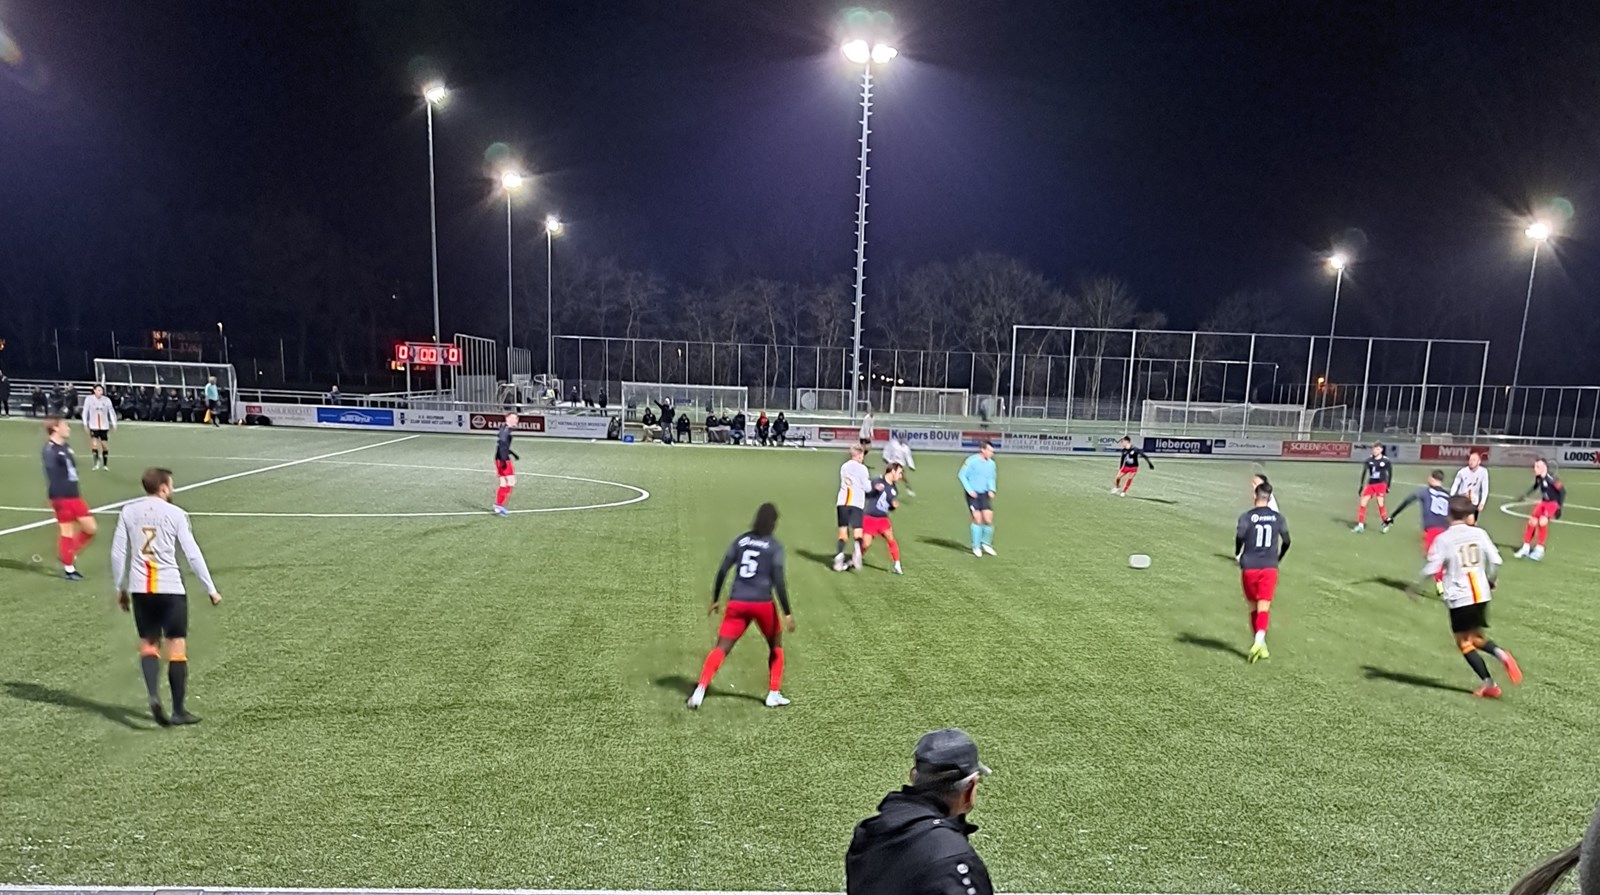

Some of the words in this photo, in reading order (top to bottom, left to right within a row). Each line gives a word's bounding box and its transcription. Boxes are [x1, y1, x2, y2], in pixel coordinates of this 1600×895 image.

[891, 430, 928, 440] Kuipers
[930, 431, 960, 440] BOUW
[1155, 439, 1201, 449] lieberom
[142, 527, 157, 555] 2
[1255, 524, 1272, 547] 11
[739, 549, 760, 578] 5
[1459, 543, 1479, 568] 10
